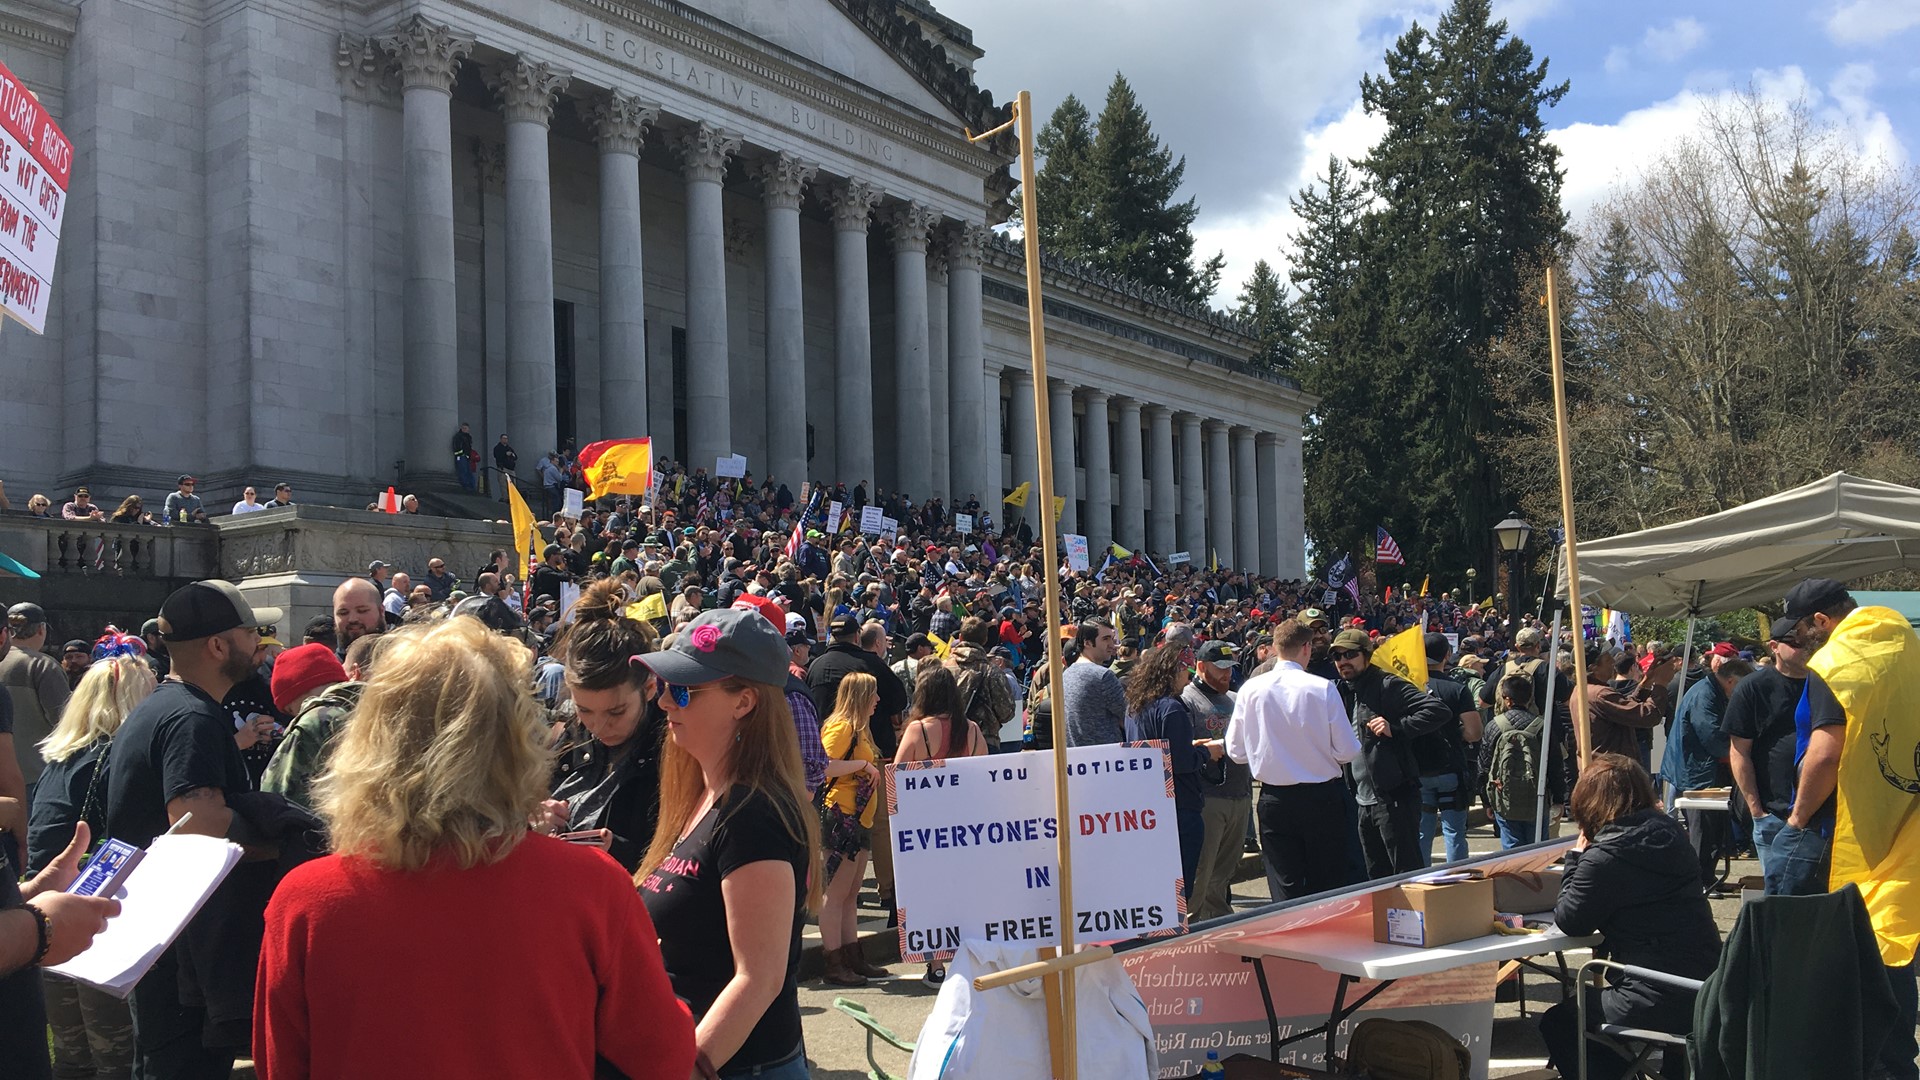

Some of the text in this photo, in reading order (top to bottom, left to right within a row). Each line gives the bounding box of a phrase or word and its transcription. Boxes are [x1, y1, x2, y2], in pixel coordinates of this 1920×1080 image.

[585, 22, 893, 162] LEGISLATIVE BUILDING
[41, 123, 70, 175] RIGHTS
[17, 157, 38, 197] NOT
[39, 176, 61, 220] GIFTS
[21, 214, 38, 253] THE
[905, 757, 1153, 791] HAVE YOU NOTICED
[899, 809, 1157, 853] EVERYONE'S DYING
[1025, 866, 1051, 889] IN
[908, 926, 960, 952] GUN
[985, 916, 1054, 942] FREE
[1077, 905, 1164, 934] ZONES
